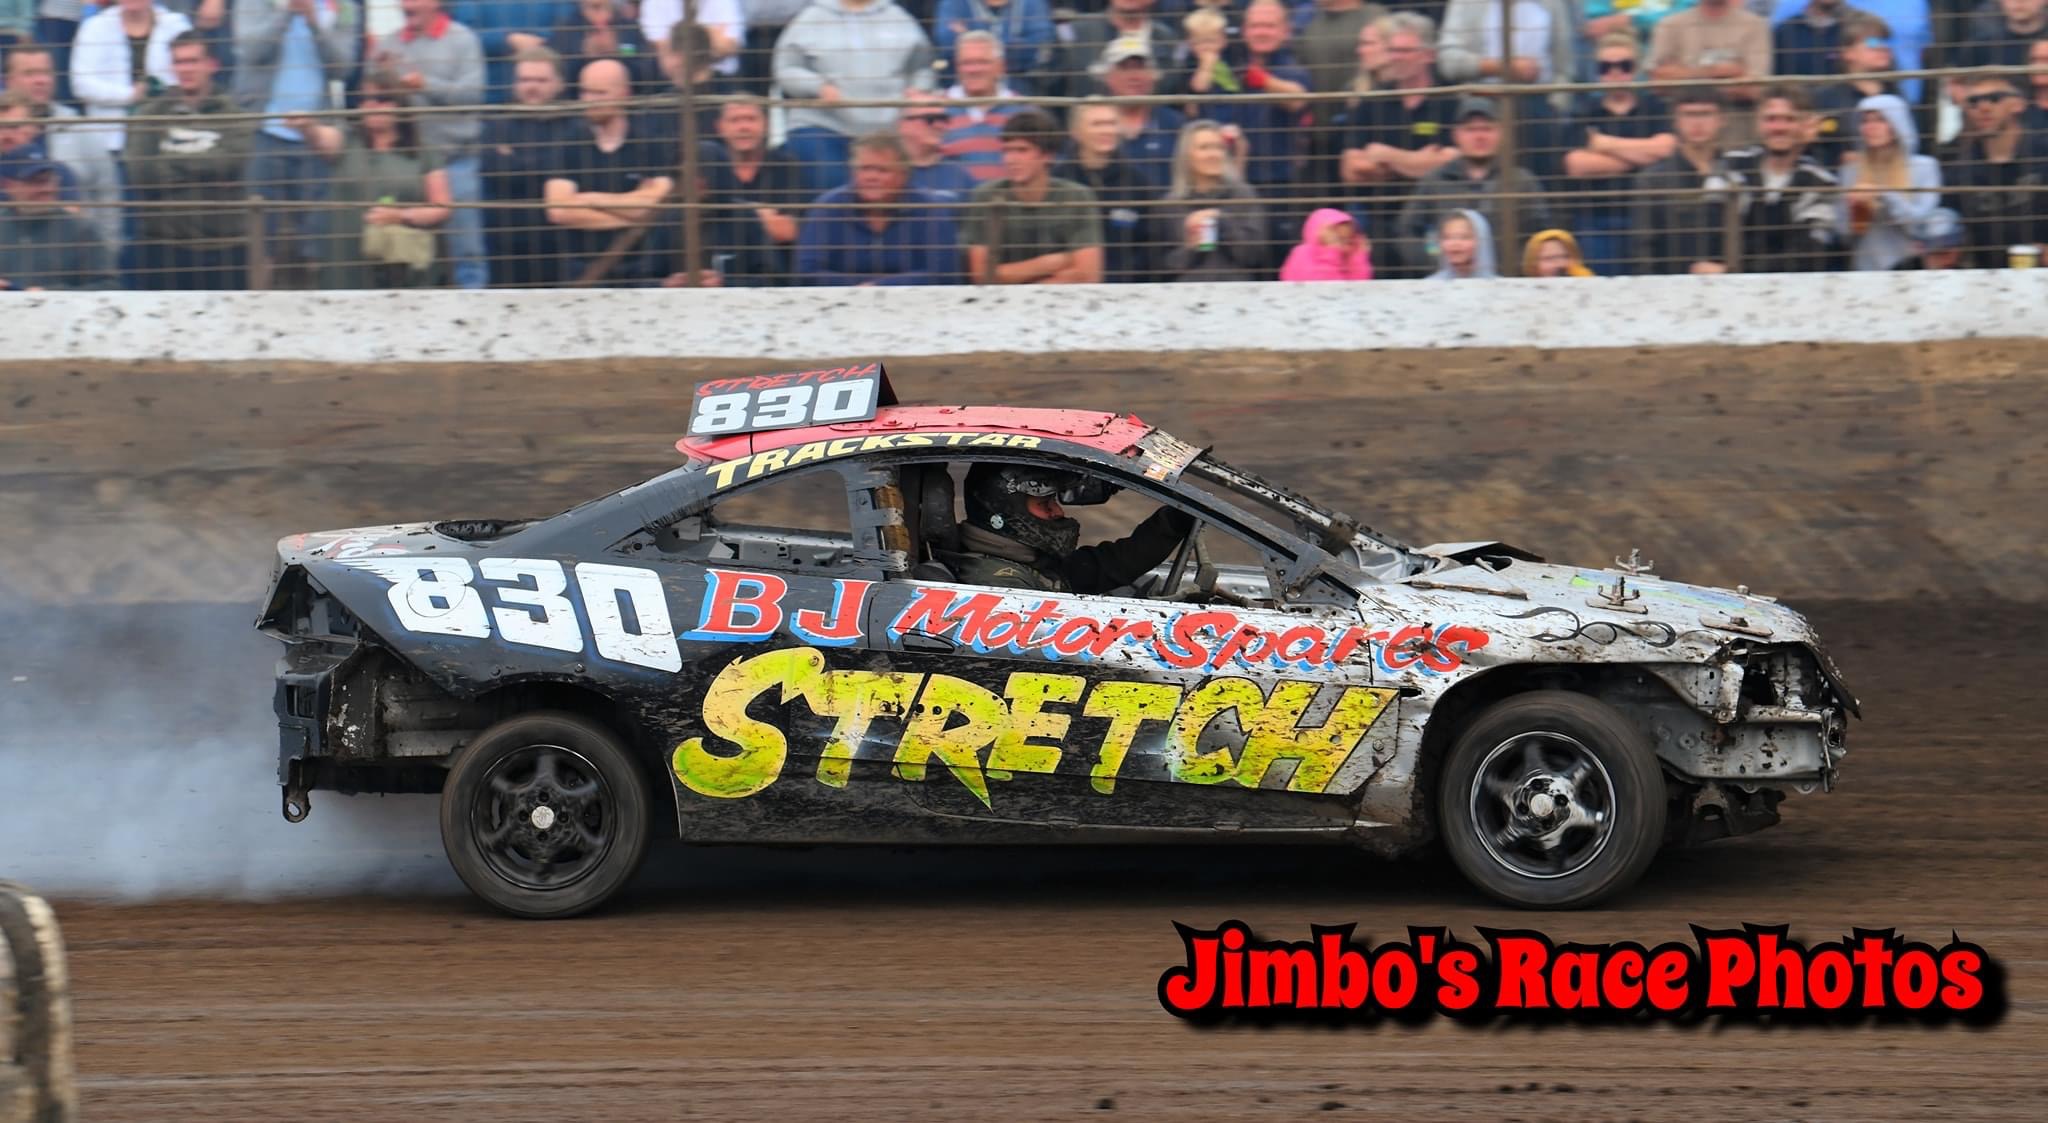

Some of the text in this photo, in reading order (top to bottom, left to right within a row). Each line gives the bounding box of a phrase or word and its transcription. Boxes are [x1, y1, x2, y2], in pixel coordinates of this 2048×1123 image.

[691, 378, 874, 434] 830
[696, 363, 877, 396] STRETCH
[706, 432, 1042, 490] TRACKSTAR
[376, 556, 683, 673] 830
[682, 568, 1490, 674] BJ Motor Spares
[672, 646, 1397, 808] STRETCH
